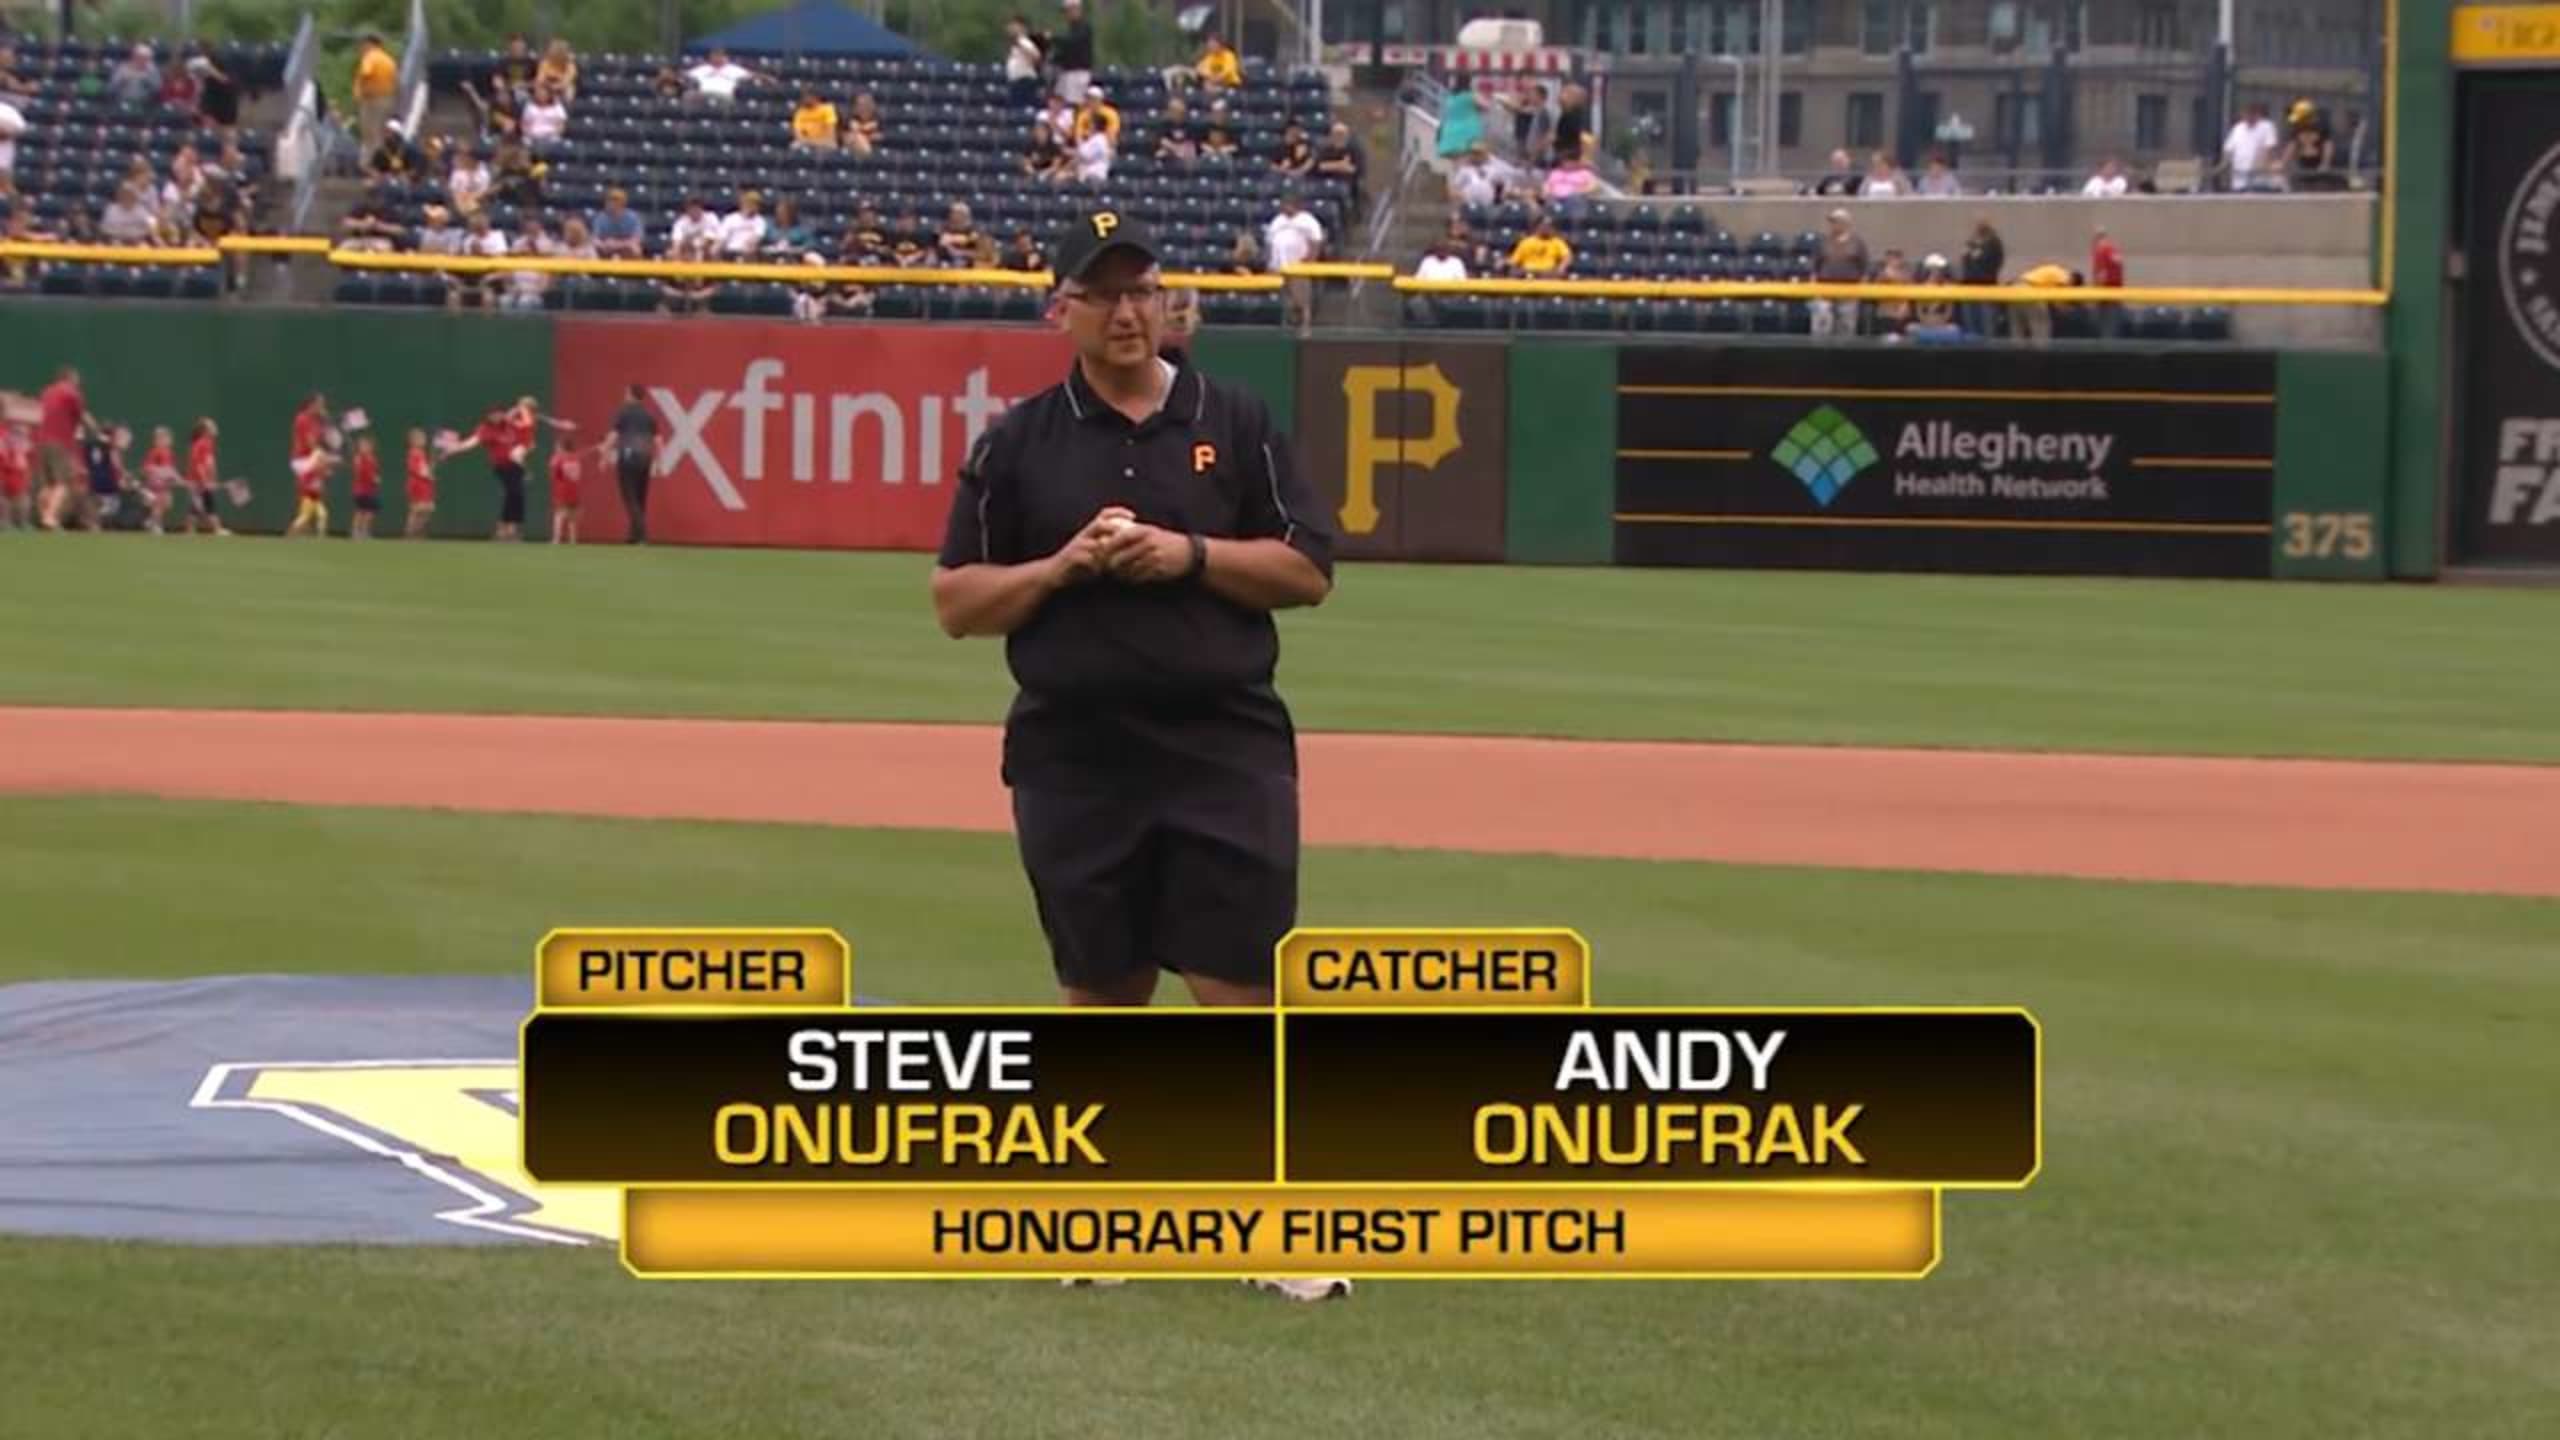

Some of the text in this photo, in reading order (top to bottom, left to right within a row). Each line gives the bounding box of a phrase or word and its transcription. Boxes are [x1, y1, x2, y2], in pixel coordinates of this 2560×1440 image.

[1091, 211, 1119, 239] P
[648, 356, 1037, 510] xfinit
[1338, 363, 1463, 533] P
[1895, 420, 2113, 470] Allegheny
[1193, 444, 1216, 472] P
[1894, 472, 2109, 499] Health Network
[2282, 513, 2373, 559] 375
